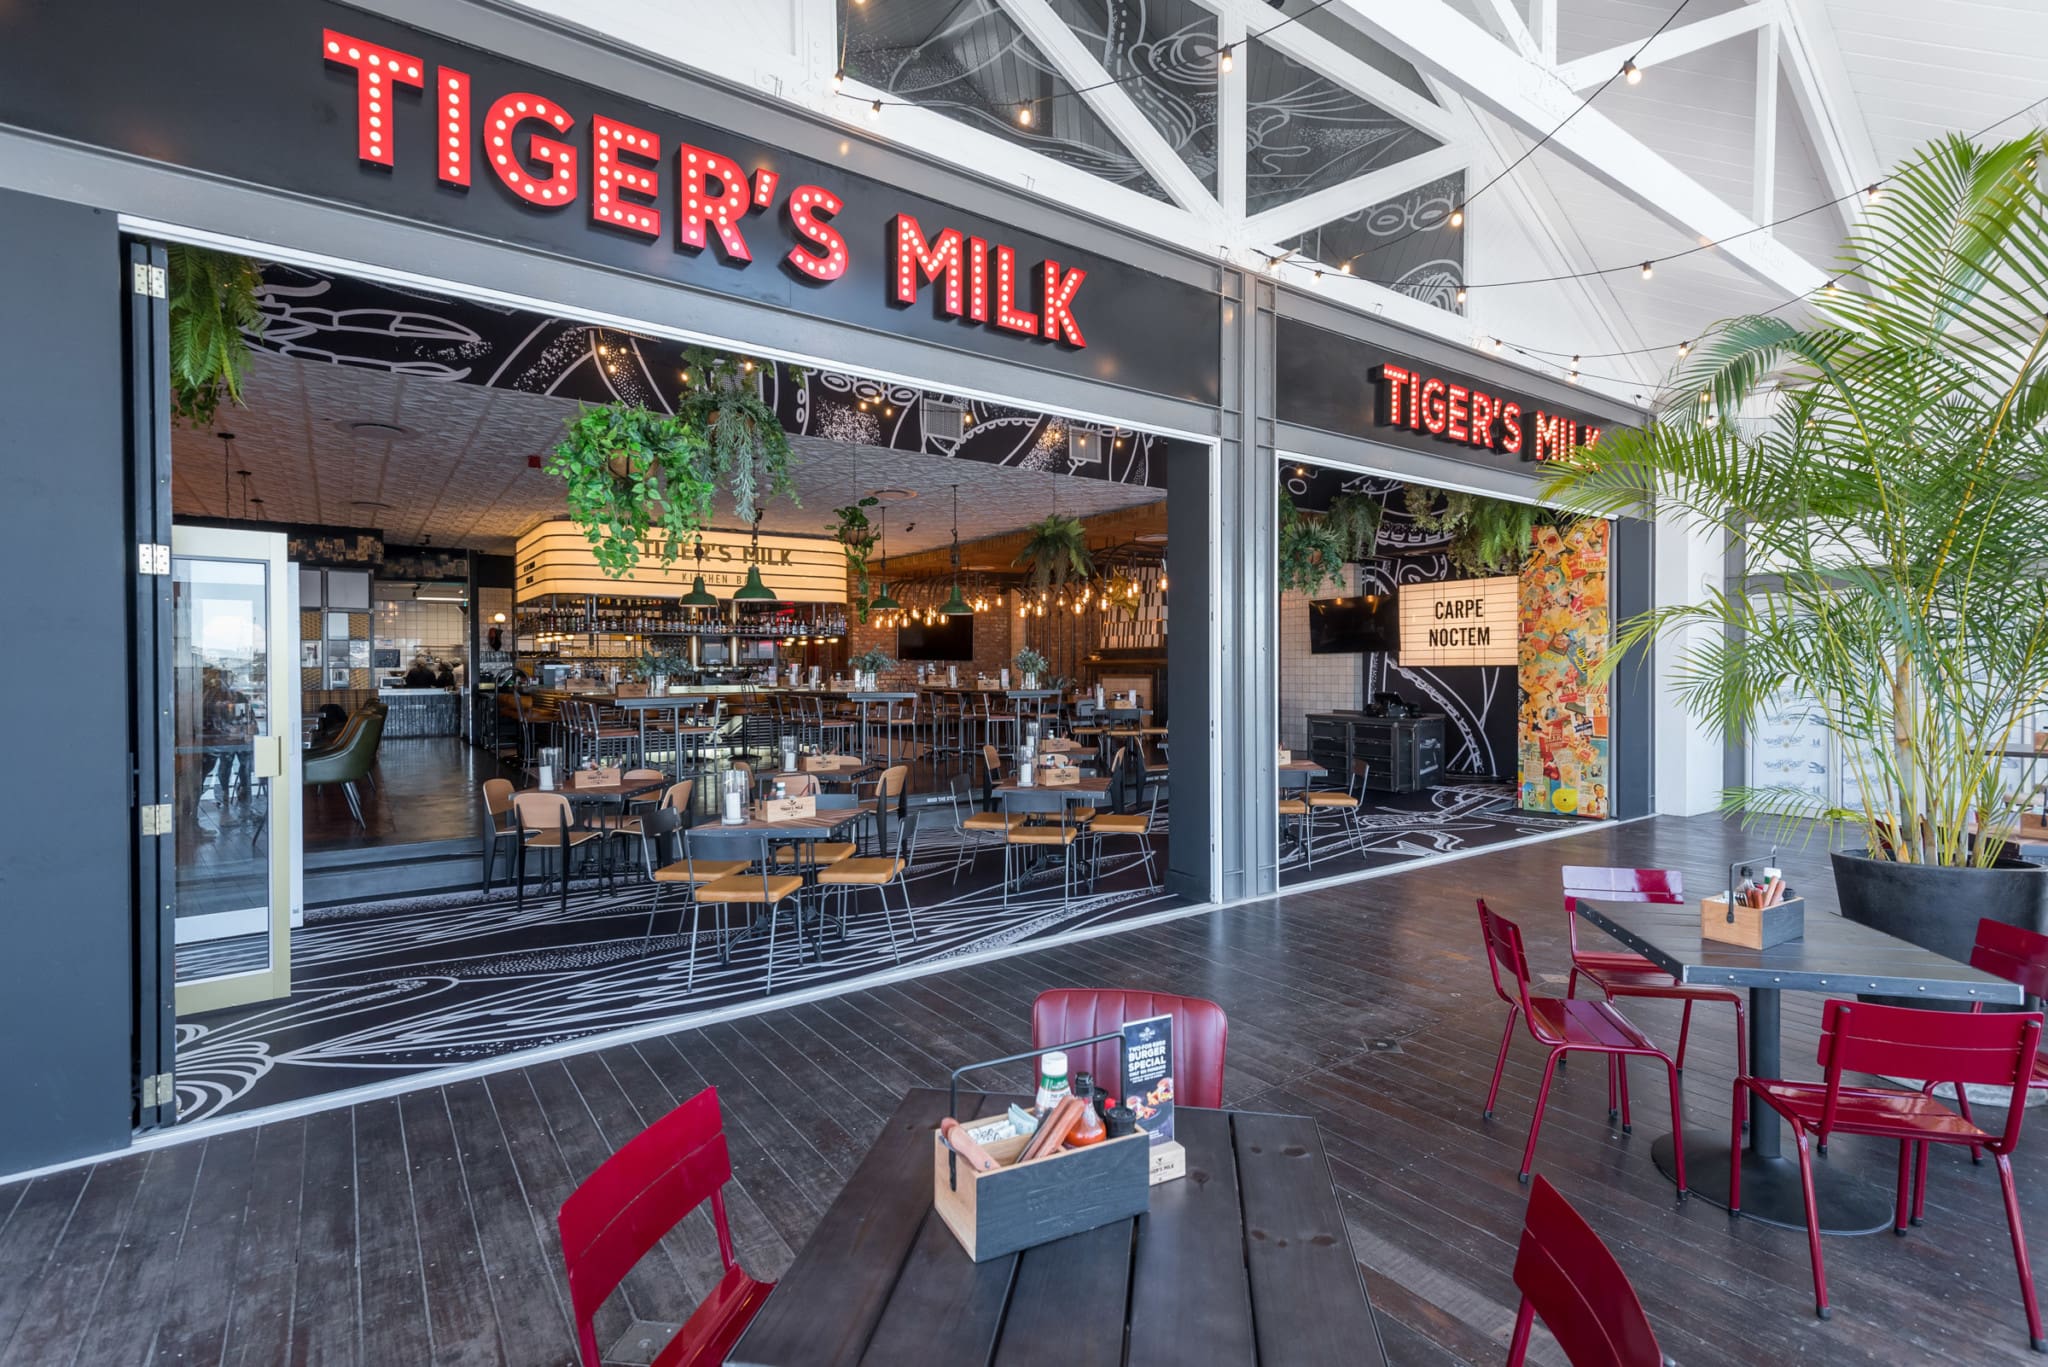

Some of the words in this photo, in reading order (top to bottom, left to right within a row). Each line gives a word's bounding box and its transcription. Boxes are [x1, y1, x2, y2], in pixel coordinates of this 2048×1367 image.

[322, 27, 850, 282] TIGER'S
[895, 213, 1087, 348] MILK
[1383, 363, 1523, 453] TIGER'S
[643, 539, 732, 563] TIER'S
[743, 545, 793, 567] MILK
[682, 573, 728, 584] KICHEN
[1435, 599, 1484, 620] CARPE
[1429, 626, 1490, 647] NOCTEM
[1128, 1056, 1166, 1072] SPECIAL
[1129, 1046, 1166, 1062] BURGER
